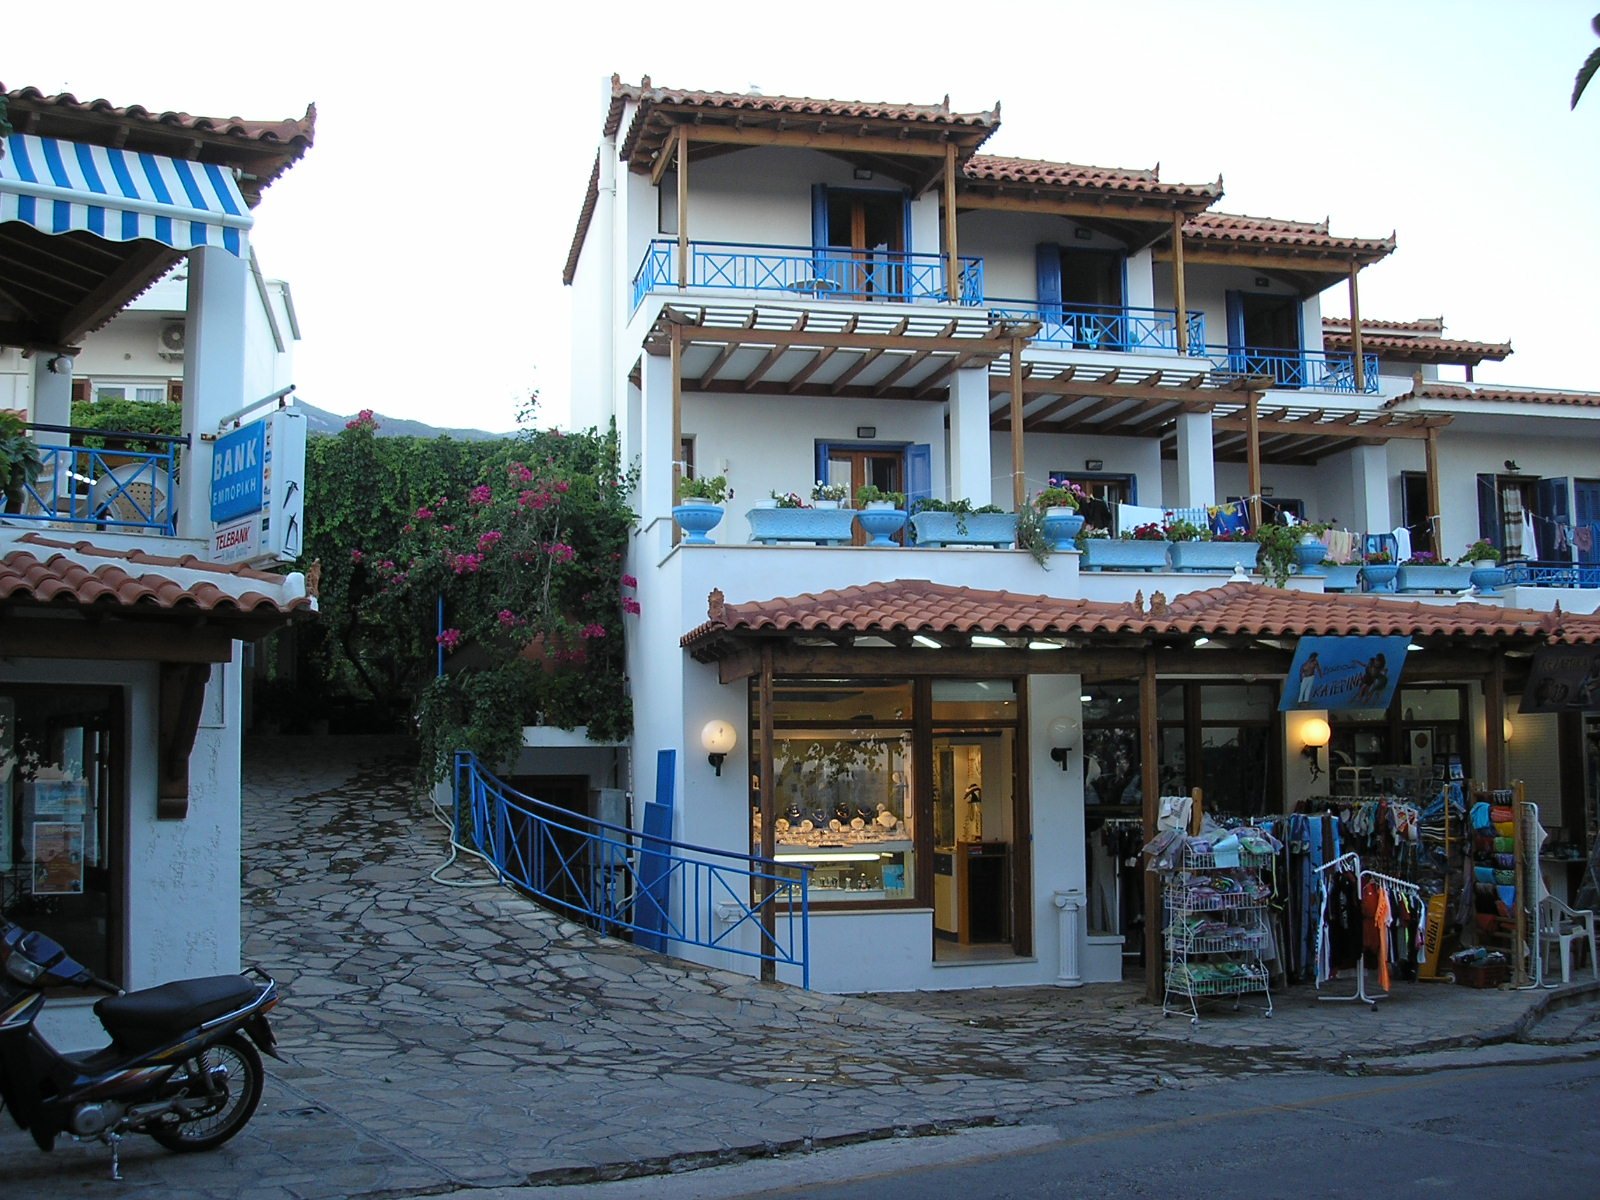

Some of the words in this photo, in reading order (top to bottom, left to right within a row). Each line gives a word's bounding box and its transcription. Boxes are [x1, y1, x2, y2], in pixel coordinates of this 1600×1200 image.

[213, 438, 257, 481] BANK
[212, 477, 257, 506] ΕΜΠΟΡΙΚΗ
[215, 526, 251, 551] TELEBANK
